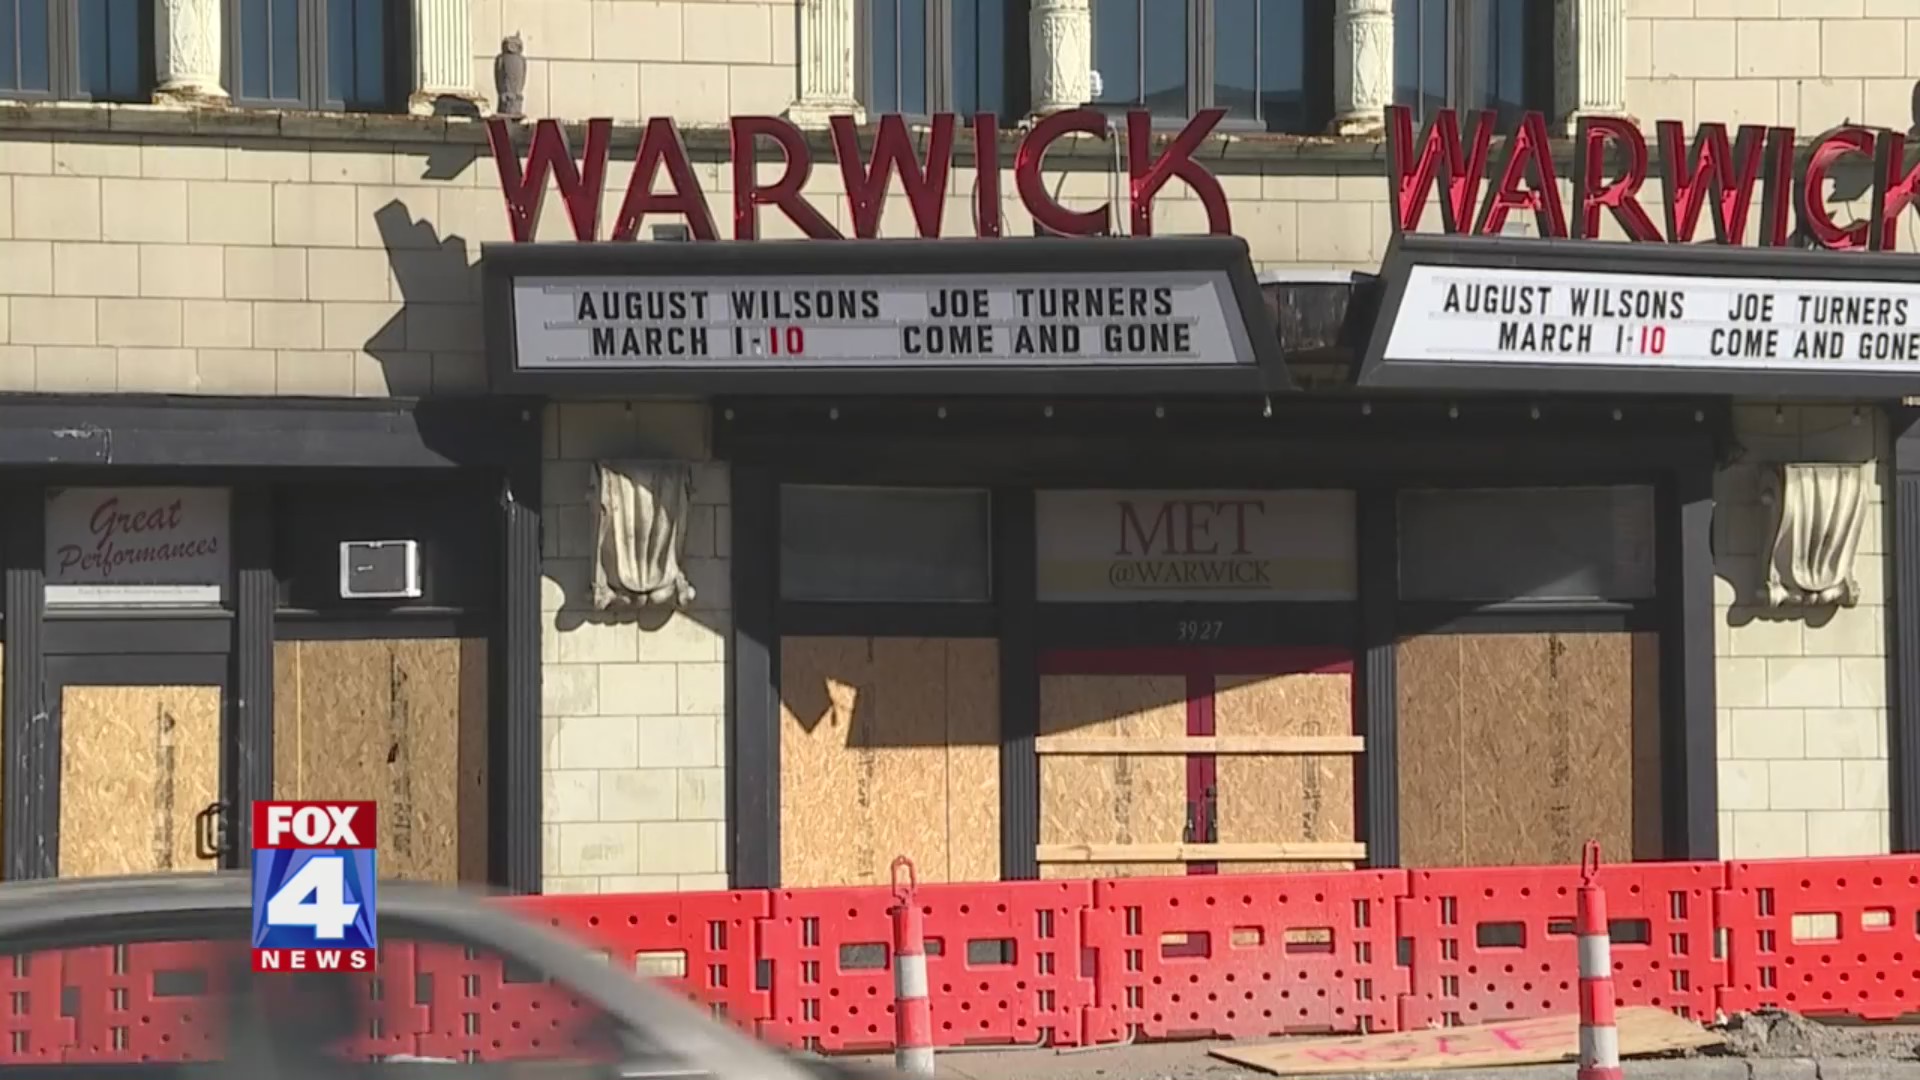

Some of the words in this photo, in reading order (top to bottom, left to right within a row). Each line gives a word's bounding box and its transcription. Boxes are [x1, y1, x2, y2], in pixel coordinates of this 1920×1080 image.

[486, 108, 1233, 243] WARWICK
[577, 290, 709, 320] AUGUST
[731, 290, 880, 319] WILSONS
[930, 288, 990, 318] JOE
[1016, 286, 1174, 317] TURNERS
[1443, 283, 1552, 315] AUGUST
[1570, 288, 1684, 319] WILSONS
[1728, 292, 1773, 323] JOE
[1799, 295, 1908, 326] TURNERS
[592, 325, 709, 356] MARCH
[902, 323, 994, 354] COME
[1014, 323, 1081, 353] AND
[1104, 321, 1191, 352] GONE
[1498, 322, 1592, 353] MARCH
[1711, 327, 1779, 358] COME
[1794, 329, 1844, 359] AND
[1859, 330, 1920, 361] GONE
[90, 495, 183, 548] Great
[1115, 499, 1265, 556] MET
[57, 535, 219, 577] Performances
[1108, 559, 1272, 590] @WARWICK
[1176, 620, 1224, 641] 3927
